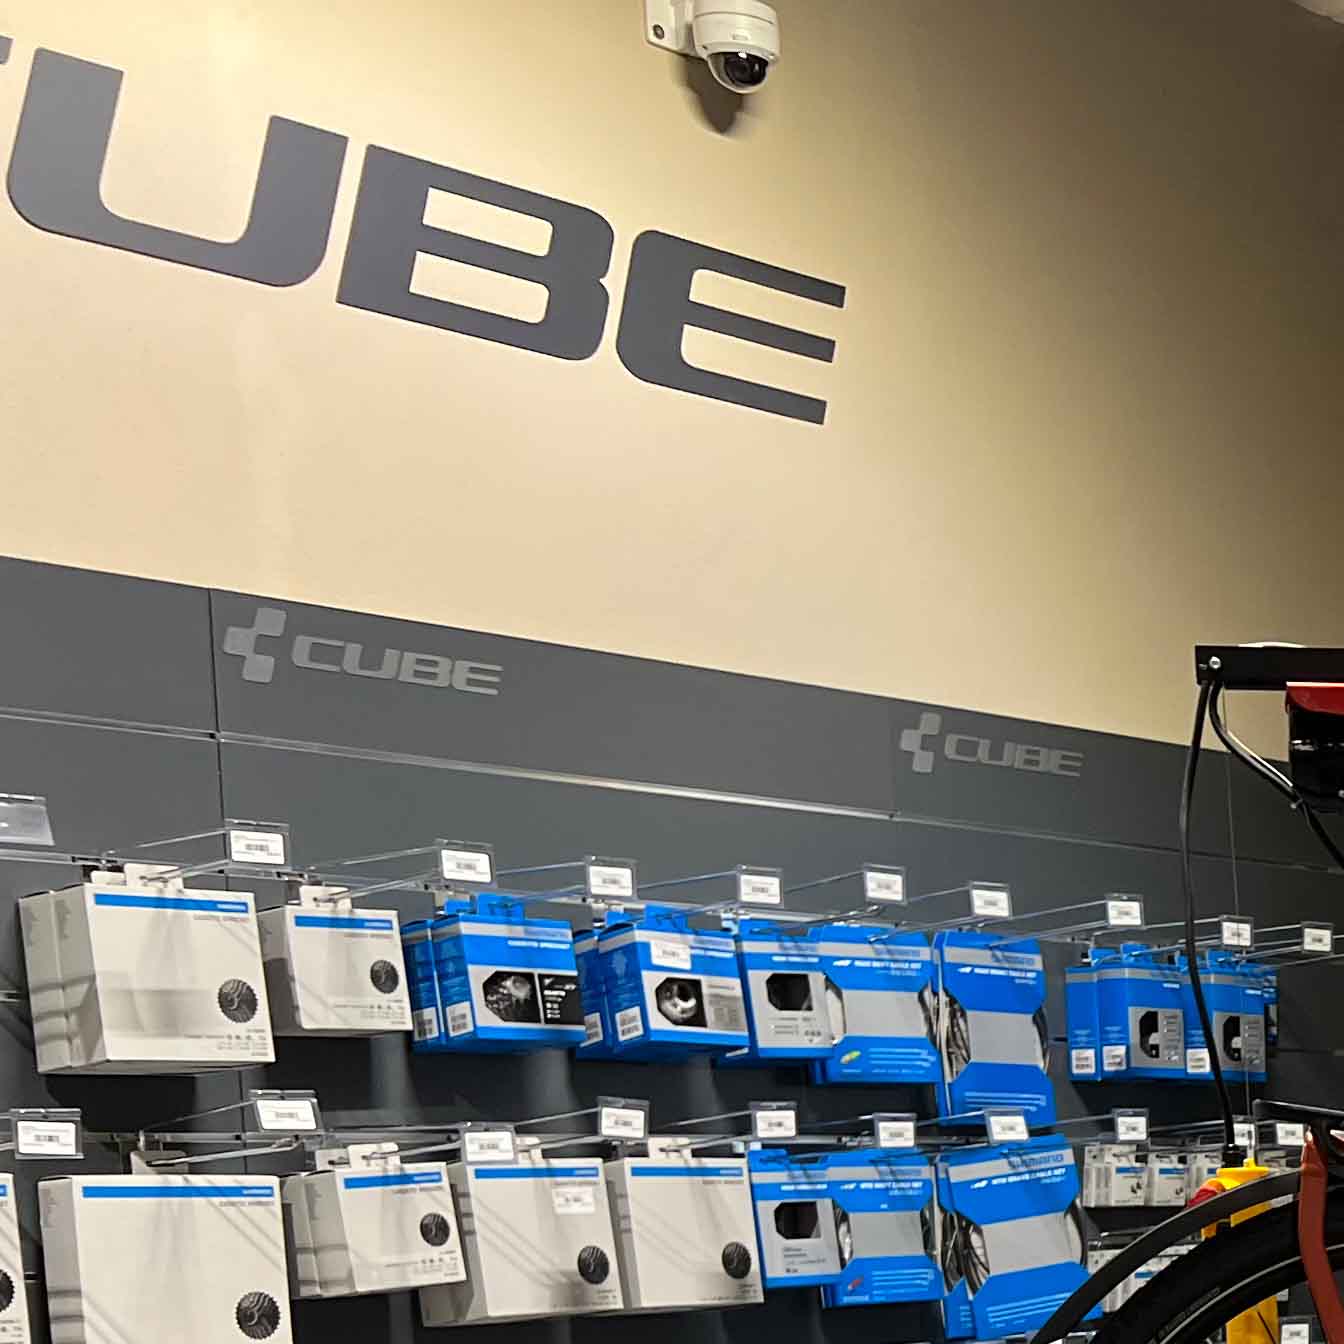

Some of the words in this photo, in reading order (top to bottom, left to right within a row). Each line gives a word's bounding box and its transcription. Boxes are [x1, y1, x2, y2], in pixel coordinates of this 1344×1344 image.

[0, 36, 846, 425] UBE
[291, 635, 504, 695] CUBE
[944, 733, 1085, 777] CUBE
